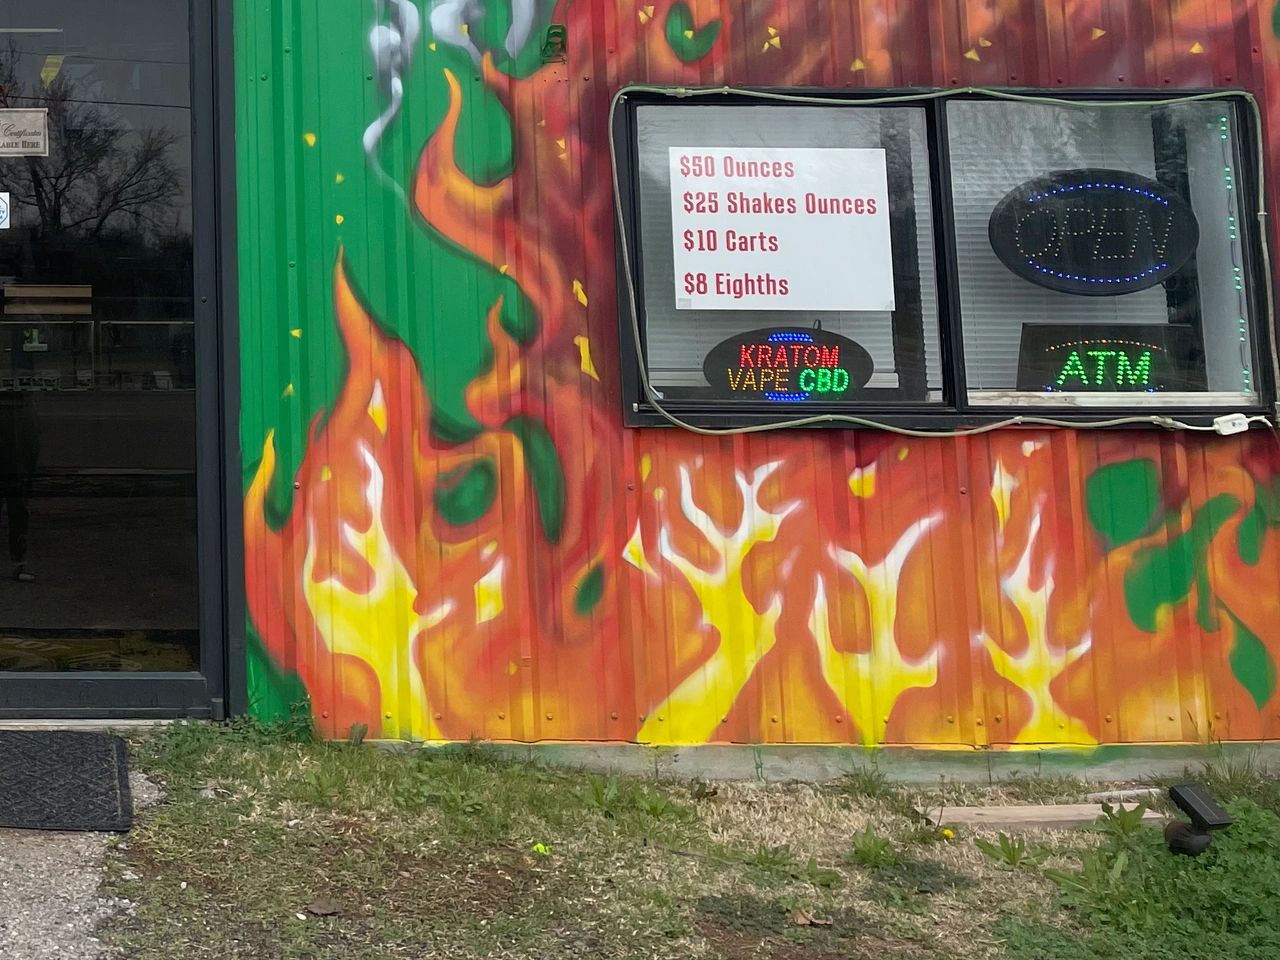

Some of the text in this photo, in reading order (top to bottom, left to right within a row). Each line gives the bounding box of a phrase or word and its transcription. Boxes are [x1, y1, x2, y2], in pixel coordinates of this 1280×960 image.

[21, 140, 41, 149] HERE
[680, 155, 795, 178] $50 Ounces
[683, 191, 878, 215] $25 Shakes Ounces
[683, 229, 779, 252] $10 Carts
[1015, 207, 1176, 260] OPEN
[684, 272, 789, 299] $8 Eighths
[740, 344, 840, 368] KRATOM
[1056, 351, 1151, 385] ATM
[727, 368, 850, 392] VAPE CBD
